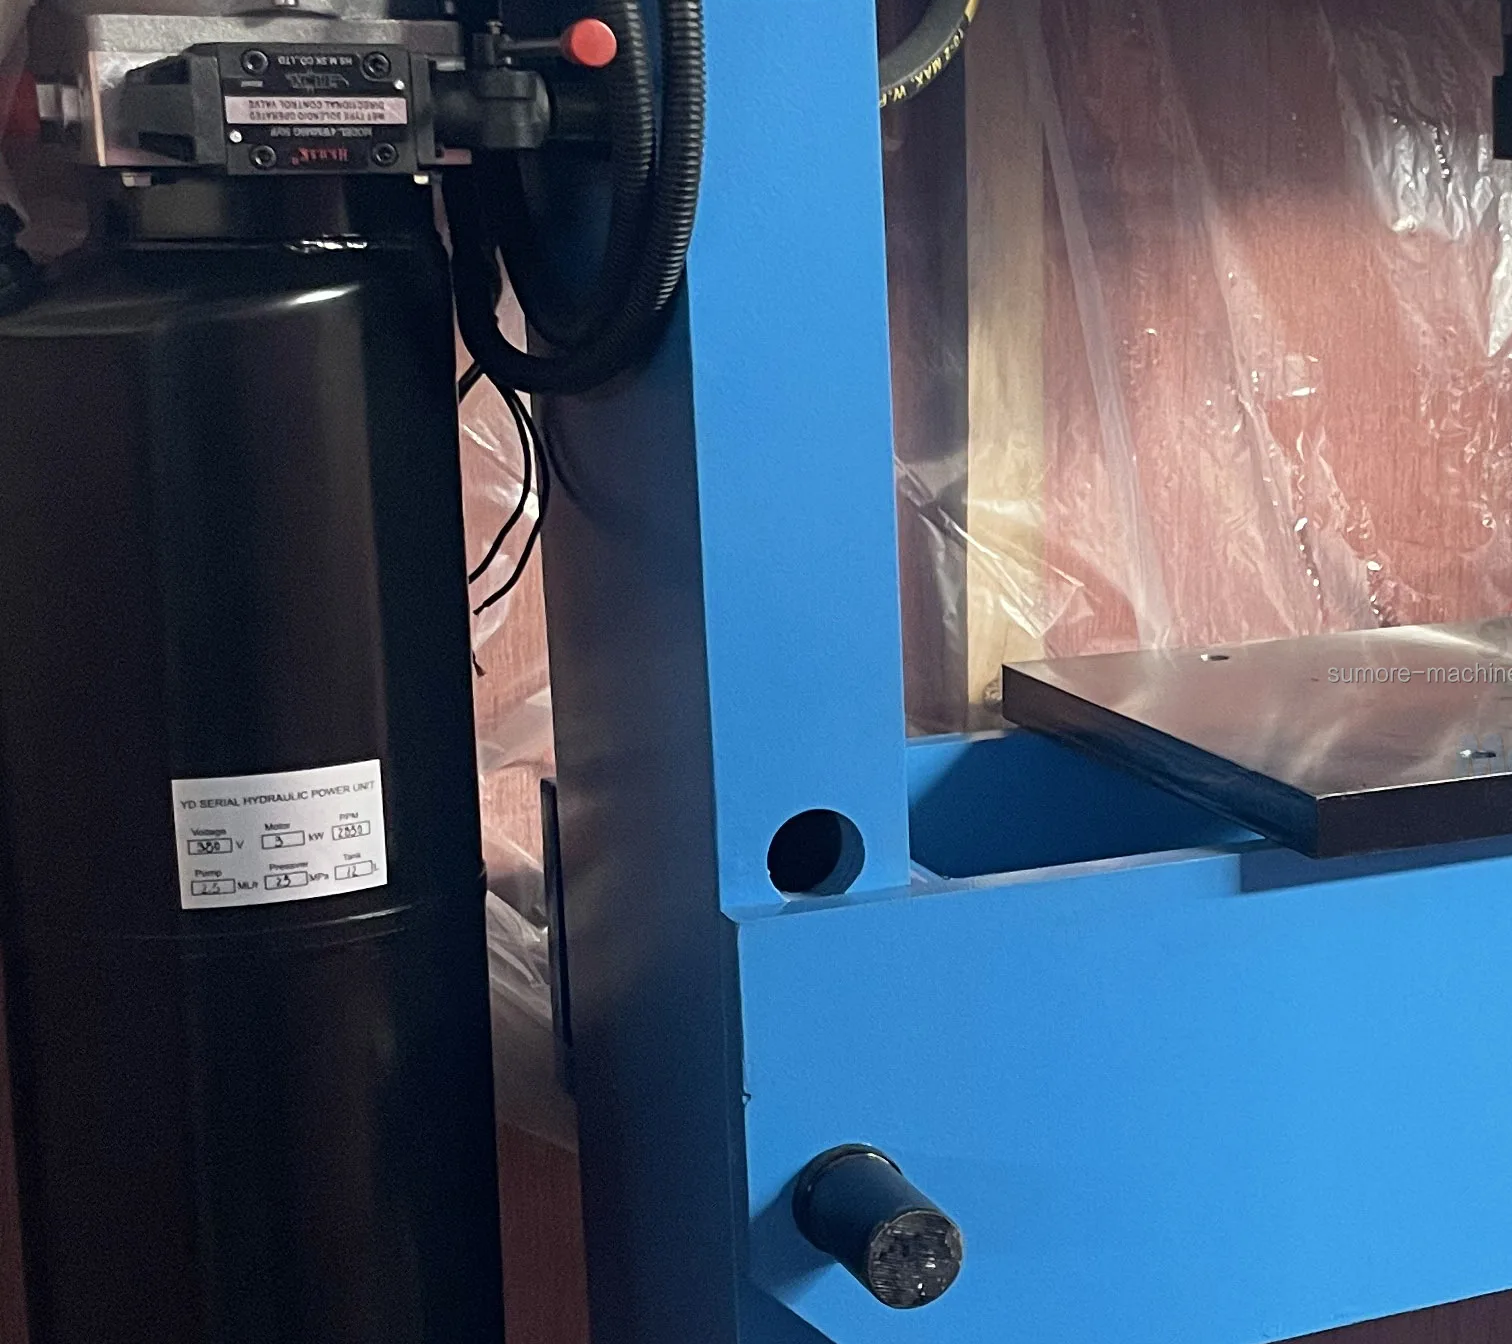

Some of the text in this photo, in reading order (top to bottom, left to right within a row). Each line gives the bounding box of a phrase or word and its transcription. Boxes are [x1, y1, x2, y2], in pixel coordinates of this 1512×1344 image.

[181, 780, 375, 809] YD SERIAL HYDRAULIC POWER UNIT
[236, 839, 245, 849] V
[194, 869, 223, 878] Pump
